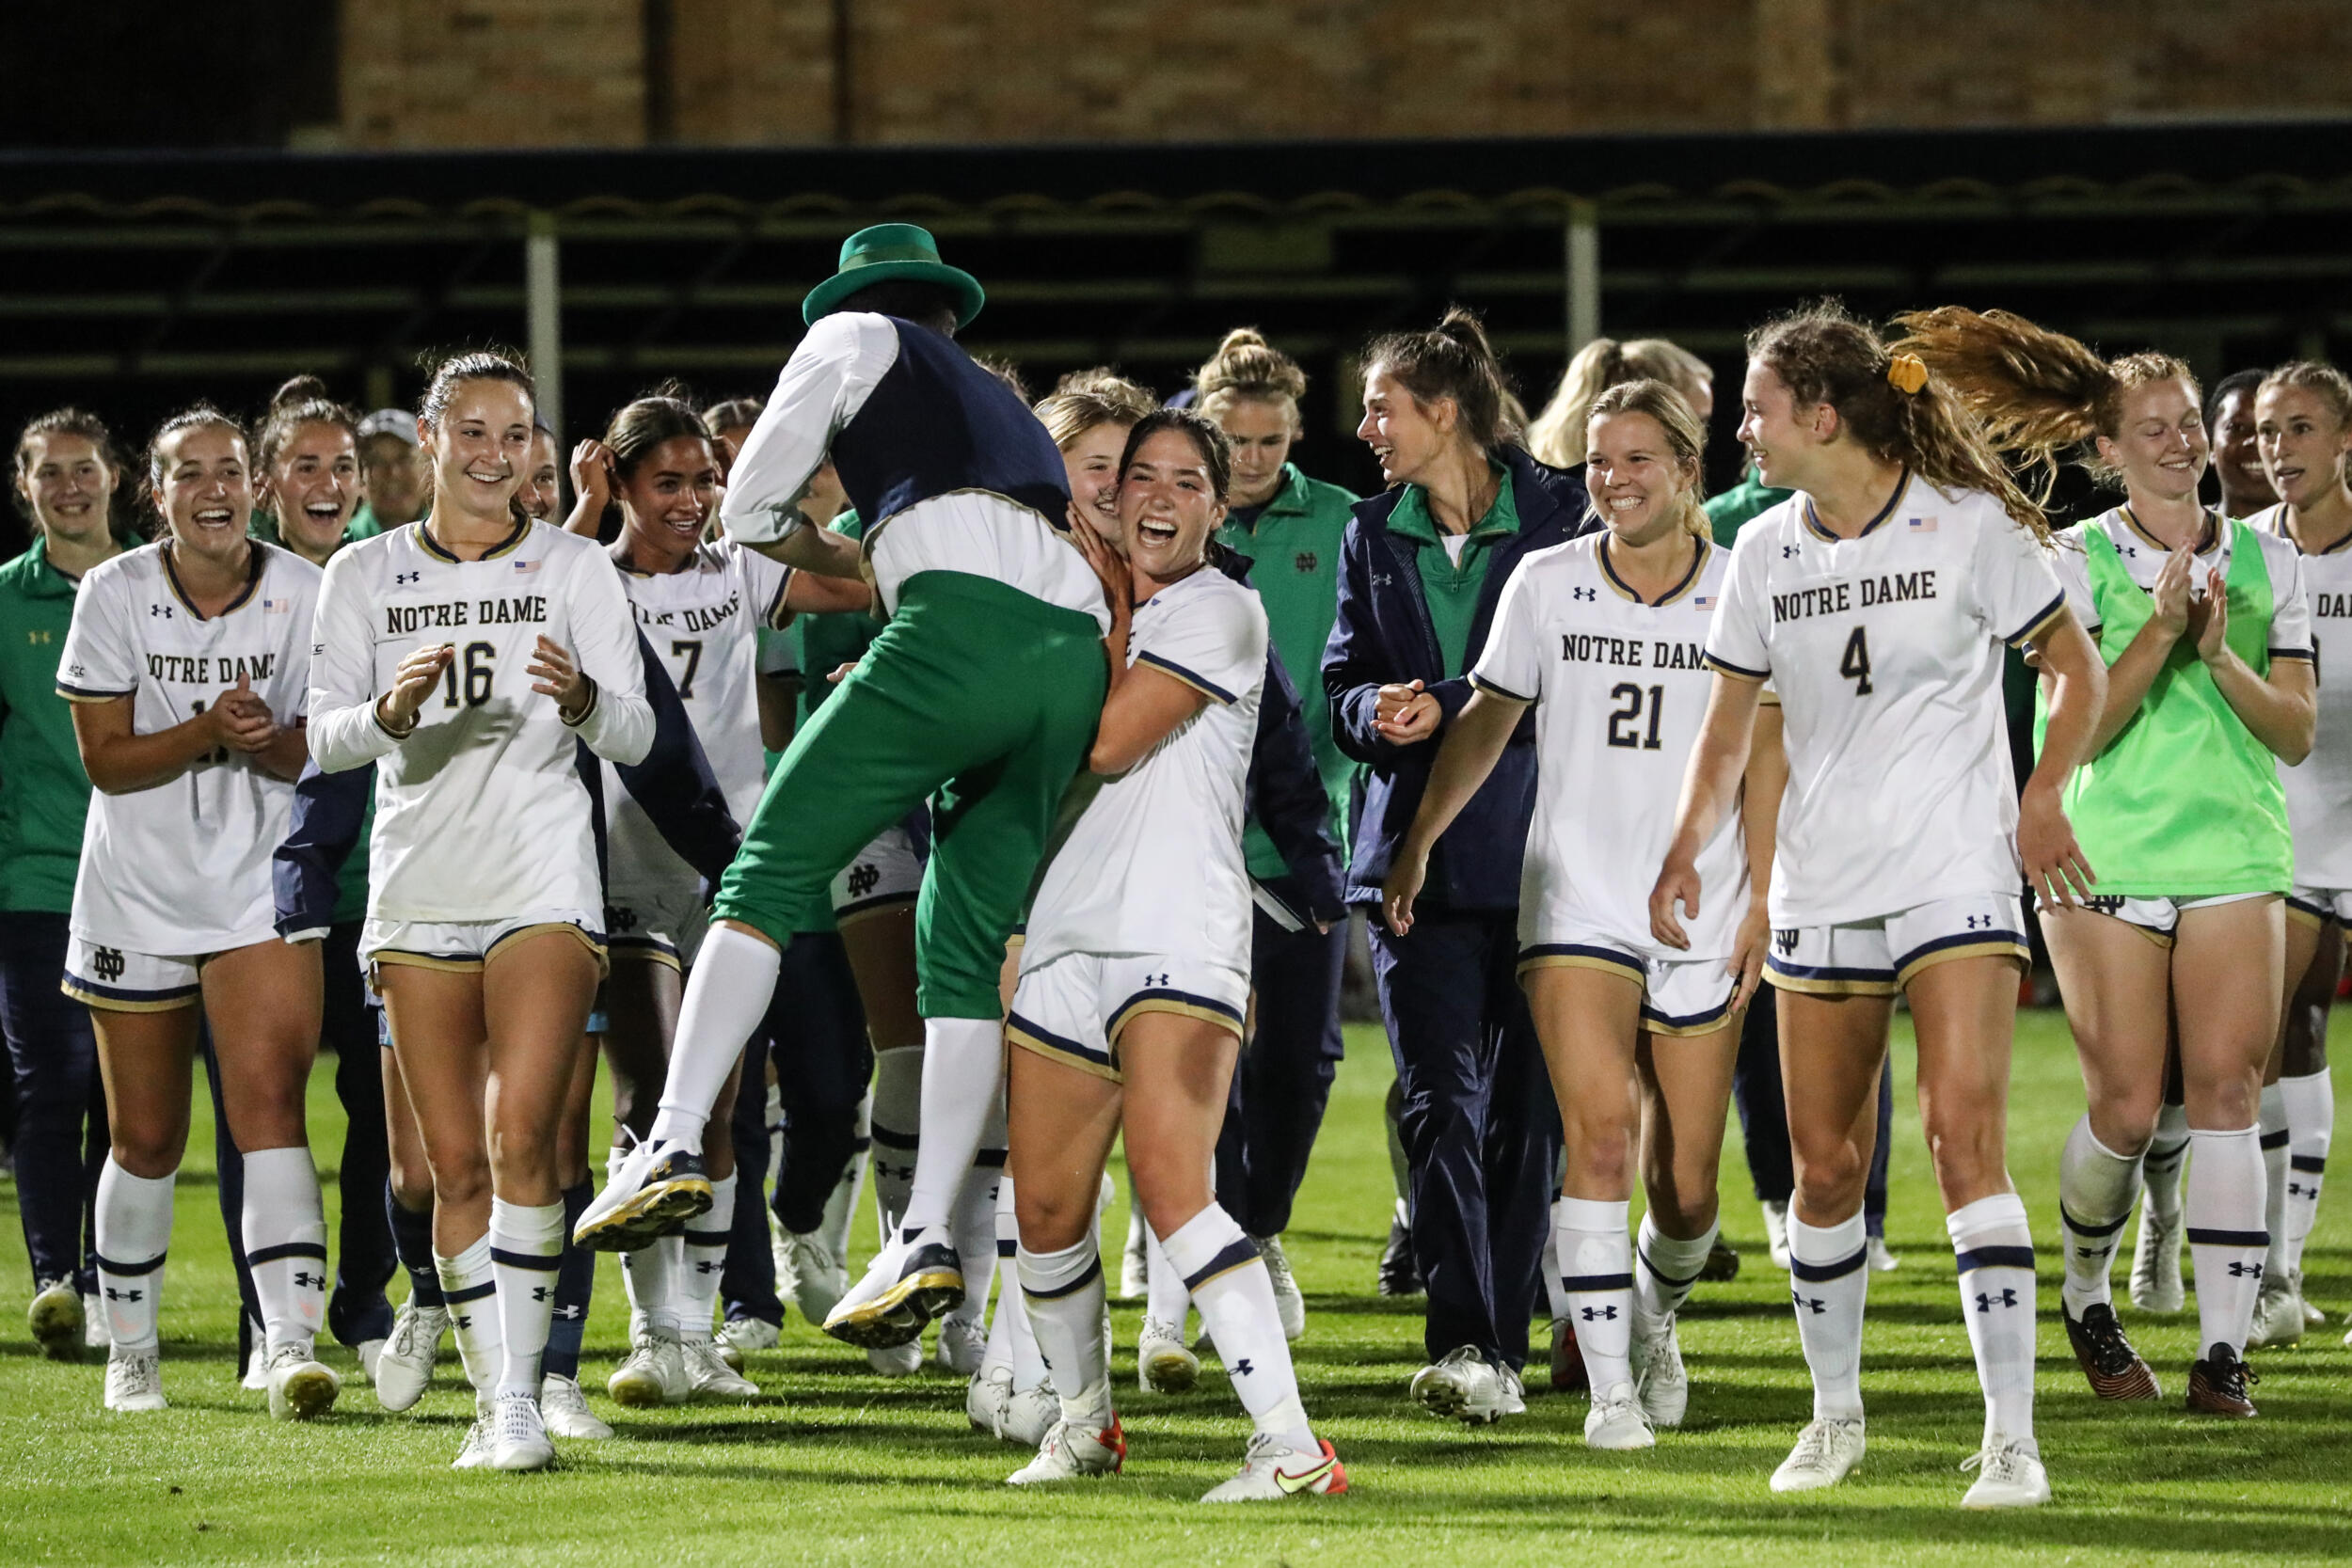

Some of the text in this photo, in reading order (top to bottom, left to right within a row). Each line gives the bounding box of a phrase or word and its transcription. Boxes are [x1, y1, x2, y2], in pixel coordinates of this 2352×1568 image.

[387, 595, 547, 634] NOTRE DAME
[1772, 570, 1936, 623] NOTRE DAME
[2317, 594, 2352, 617] DA
[443, 640, 497, 709] 16
[672, 639, 703, 700] 7
[1562, 634, 1711, 671] NOTRE DAM
[1839, 625, 1873, 697] 4
[1607, 681, 1664, 751] 21
